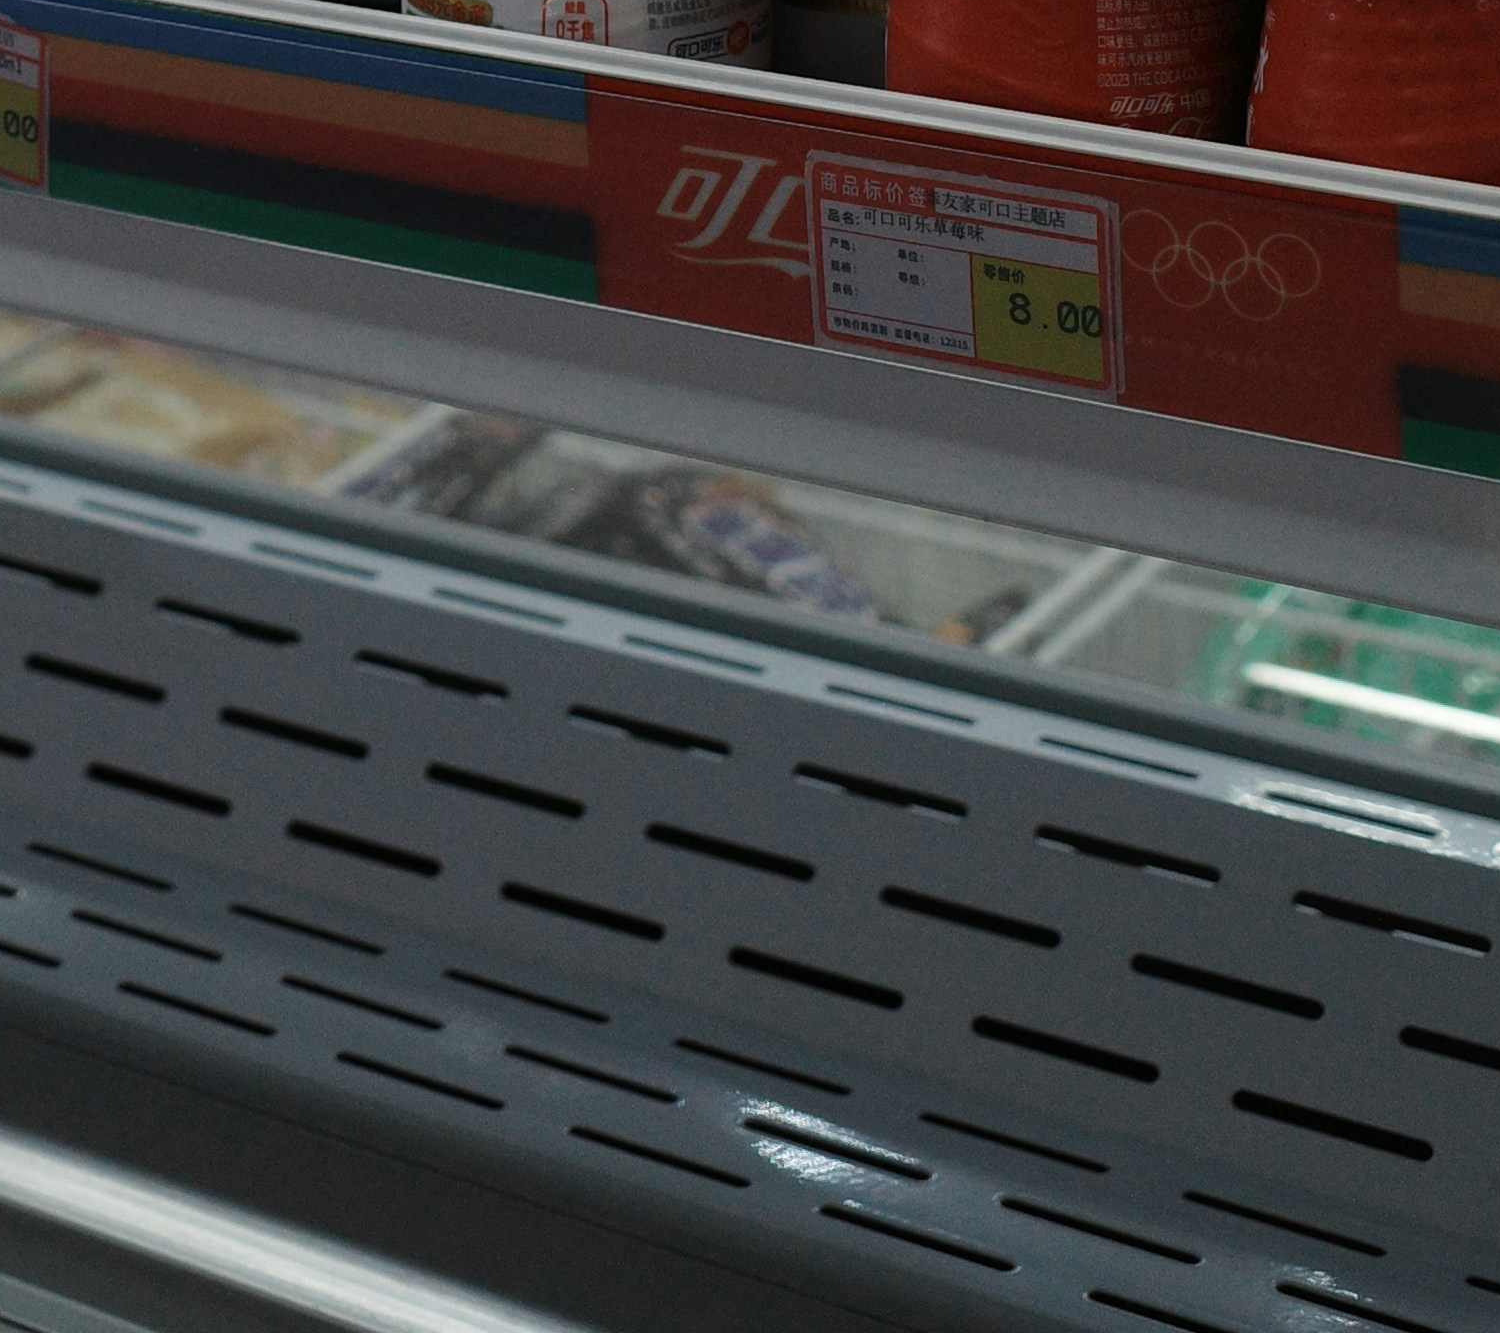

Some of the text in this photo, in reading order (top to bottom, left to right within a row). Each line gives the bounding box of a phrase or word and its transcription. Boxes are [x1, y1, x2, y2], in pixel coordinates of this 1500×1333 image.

[819, 170, 928, 210] 商品标价签
[827, 206, 985, 243] 品名: 可口可乐草莓味
[982, 262, 1027, 286] 零售价
[1008, 291, 1103, 338] 8.00
